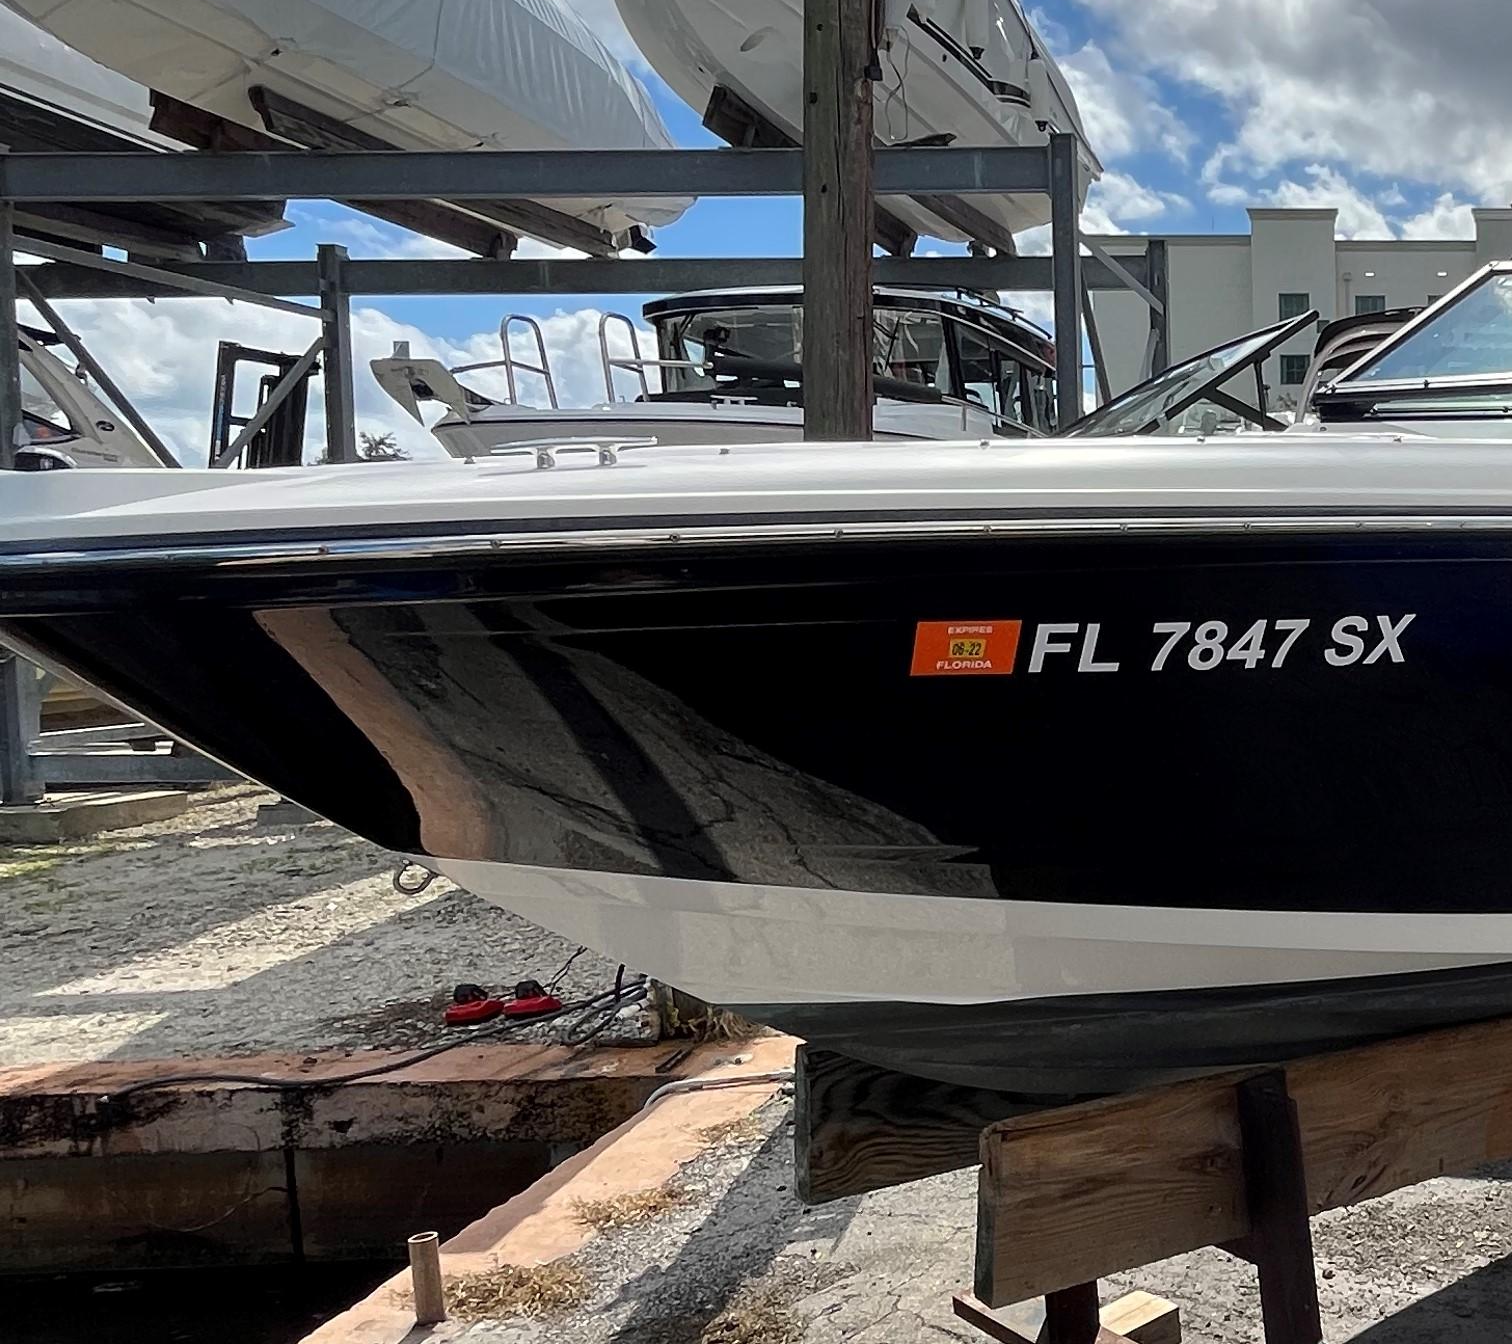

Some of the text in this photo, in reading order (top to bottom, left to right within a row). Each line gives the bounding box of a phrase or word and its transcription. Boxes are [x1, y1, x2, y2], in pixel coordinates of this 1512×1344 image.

[947, 625, 993, 635] EXPIRES
[1027, 613, 1417, 673] FL 7847 SX
[936, 660, 992, 670] FLORIDA
